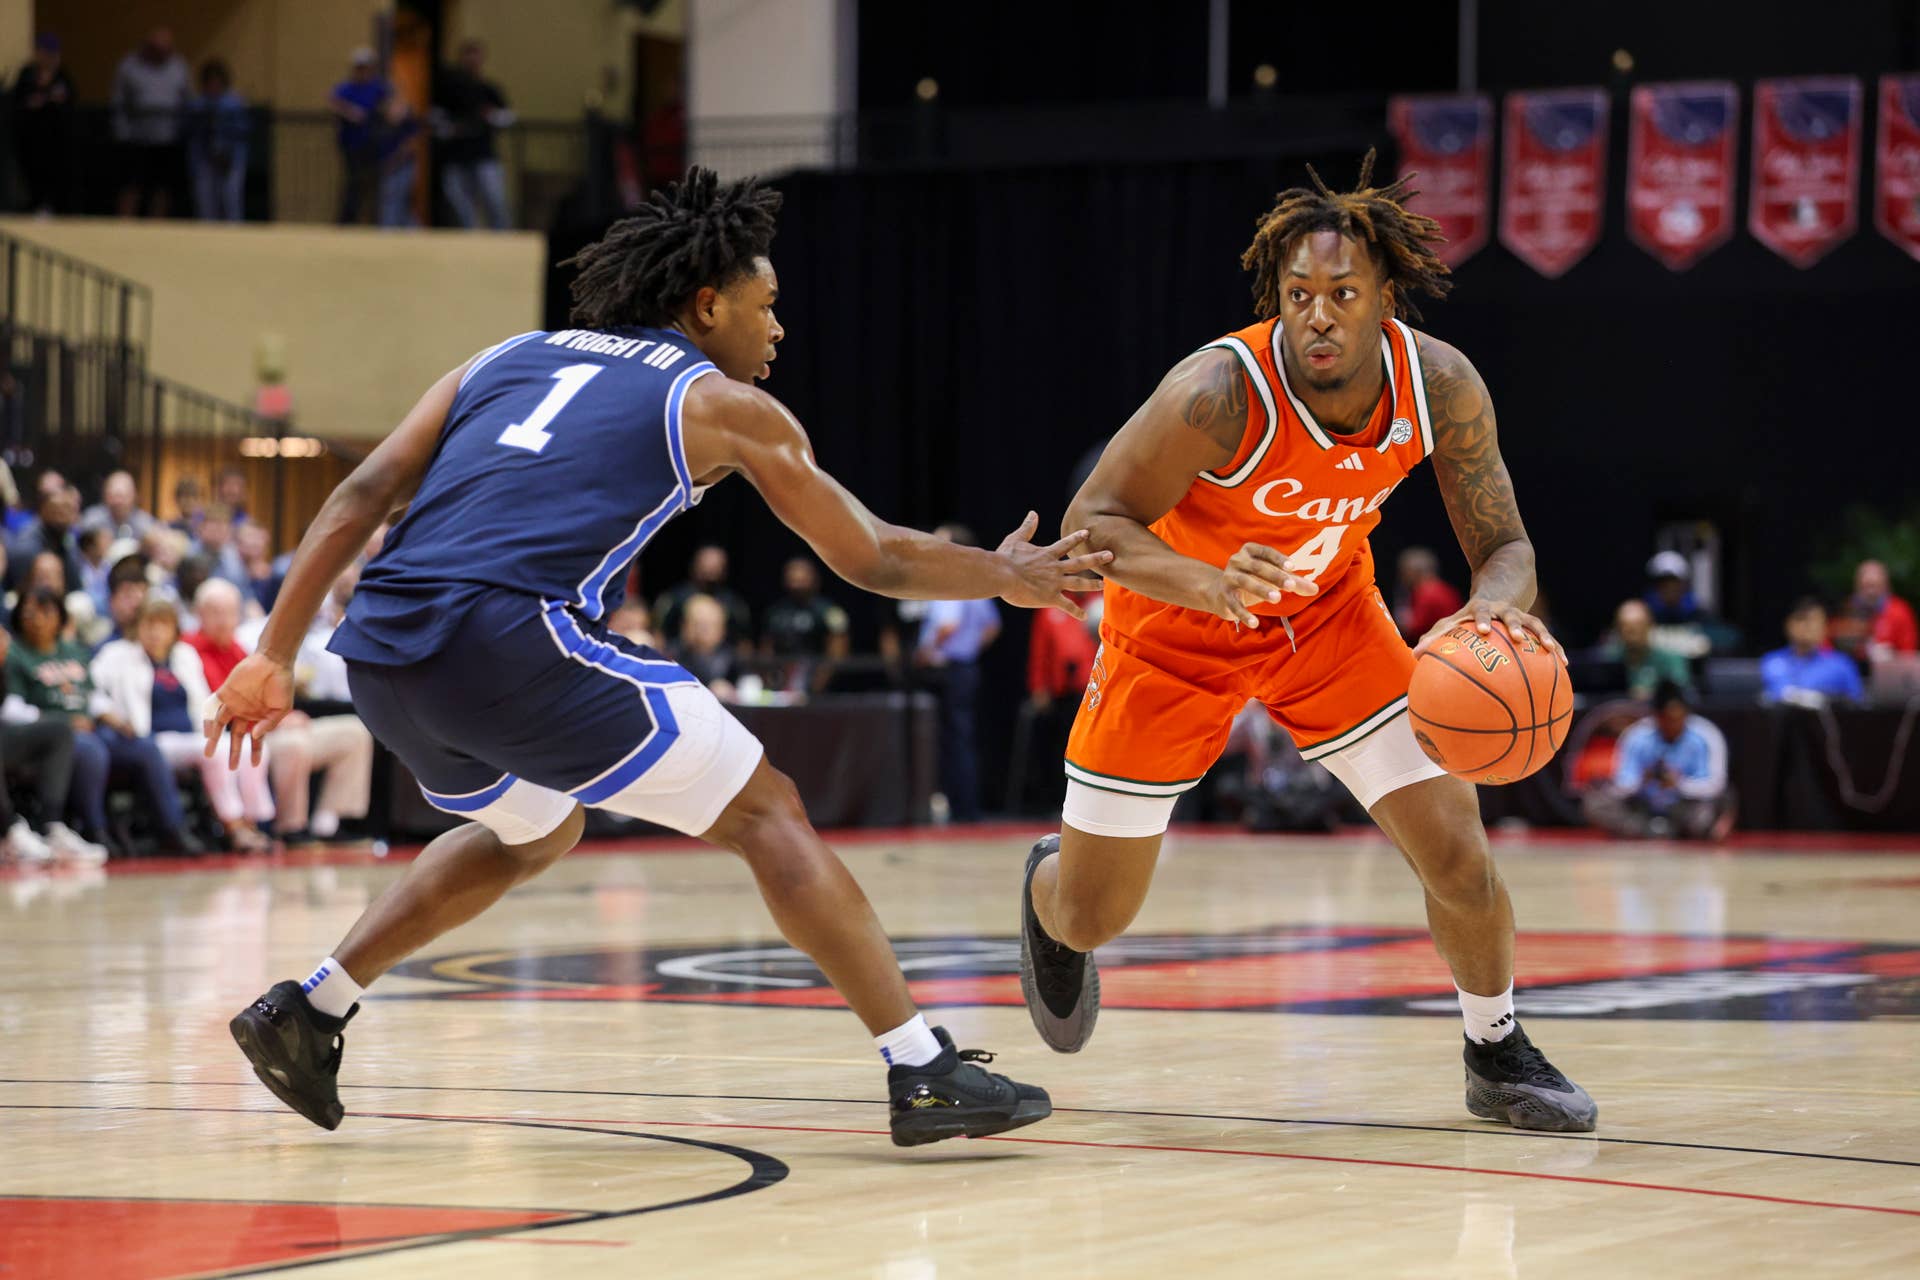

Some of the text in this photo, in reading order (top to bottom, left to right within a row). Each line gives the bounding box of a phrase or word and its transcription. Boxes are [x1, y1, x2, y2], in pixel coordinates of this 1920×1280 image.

[544, 328, 686, 371] WRIGHT III
[495, 363, 606, 453] 1
[1252, 476, 1404, 523] Cane
[1287, 524, 1349, 582] 4
